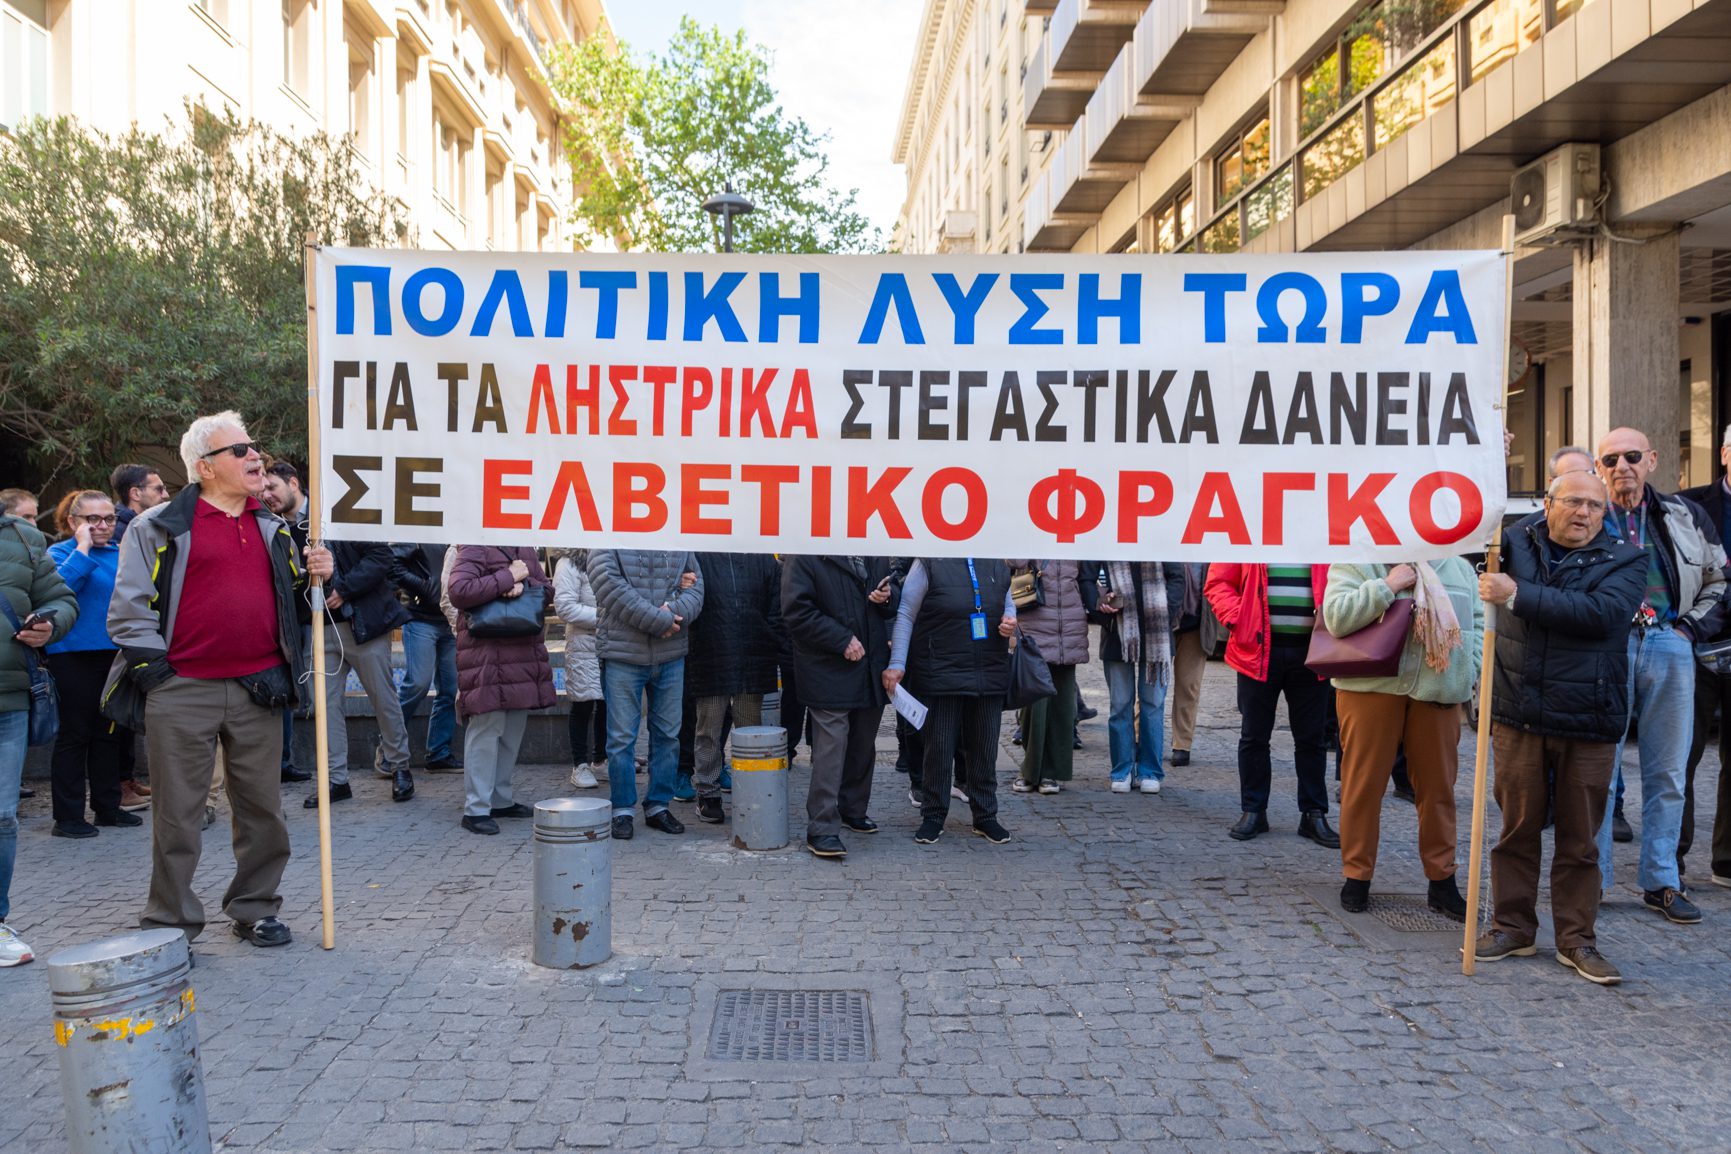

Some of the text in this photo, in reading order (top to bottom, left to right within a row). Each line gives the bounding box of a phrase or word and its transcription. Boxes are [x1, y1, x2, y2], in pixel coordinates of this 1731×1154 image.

[336, 266, 1477, 344] ΠΟΛΙΤΙΚΗ ΛΥΣΗ ΤΩΡΑ
[333, 361, 1479, 445] ΓΙΑ ΤΑ ΛΗΣΤΡΙΚΑ ΣΤΕΓΑΣΤΙΚΑ ΔΑΝΕΙΑ
[331, 455, 1484, 546] ΣΕ ΕΛΒΕΤΙΚΟ ΦΡΑΓΚΟ
